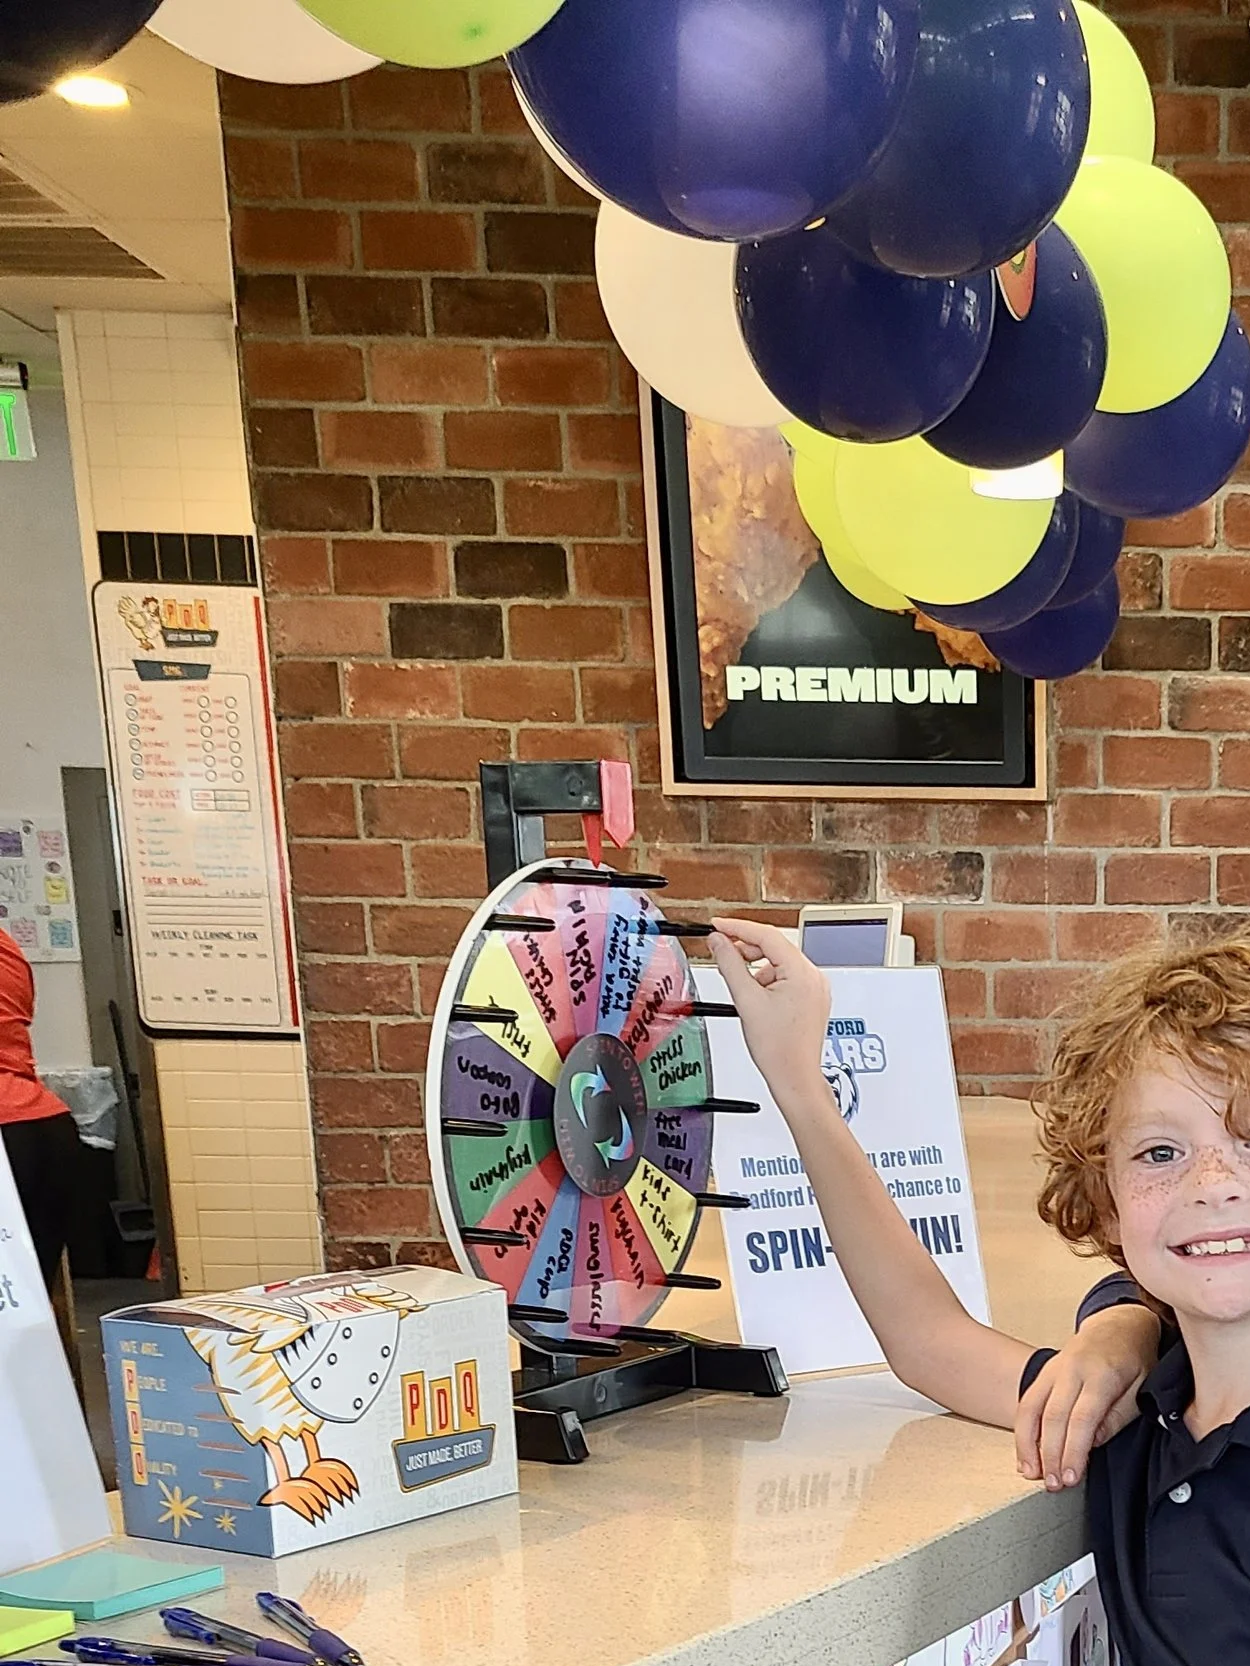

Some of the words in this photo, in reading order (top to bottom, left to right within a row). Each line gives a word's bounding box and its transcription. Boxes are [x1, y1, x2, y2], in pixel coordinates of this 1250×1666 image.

[725, 666, 978, 704] PREMIUM
[566, 950, 586, 1006] SPIN
[826, 1019, 865, 1037] FORD
[820, 1037, 886, 1073] ARS
[880, 1150, 907, 1168] are
[909, 1145, 943, 1166] with
[730, 1186, 805, 1211] adford
[886, 1178, 944, 1198] chance
[946, 1176, 962, 1194] to
[408, 1371, 475, 1430] PDQ
[405, 1453, 428, 1471] JUST
